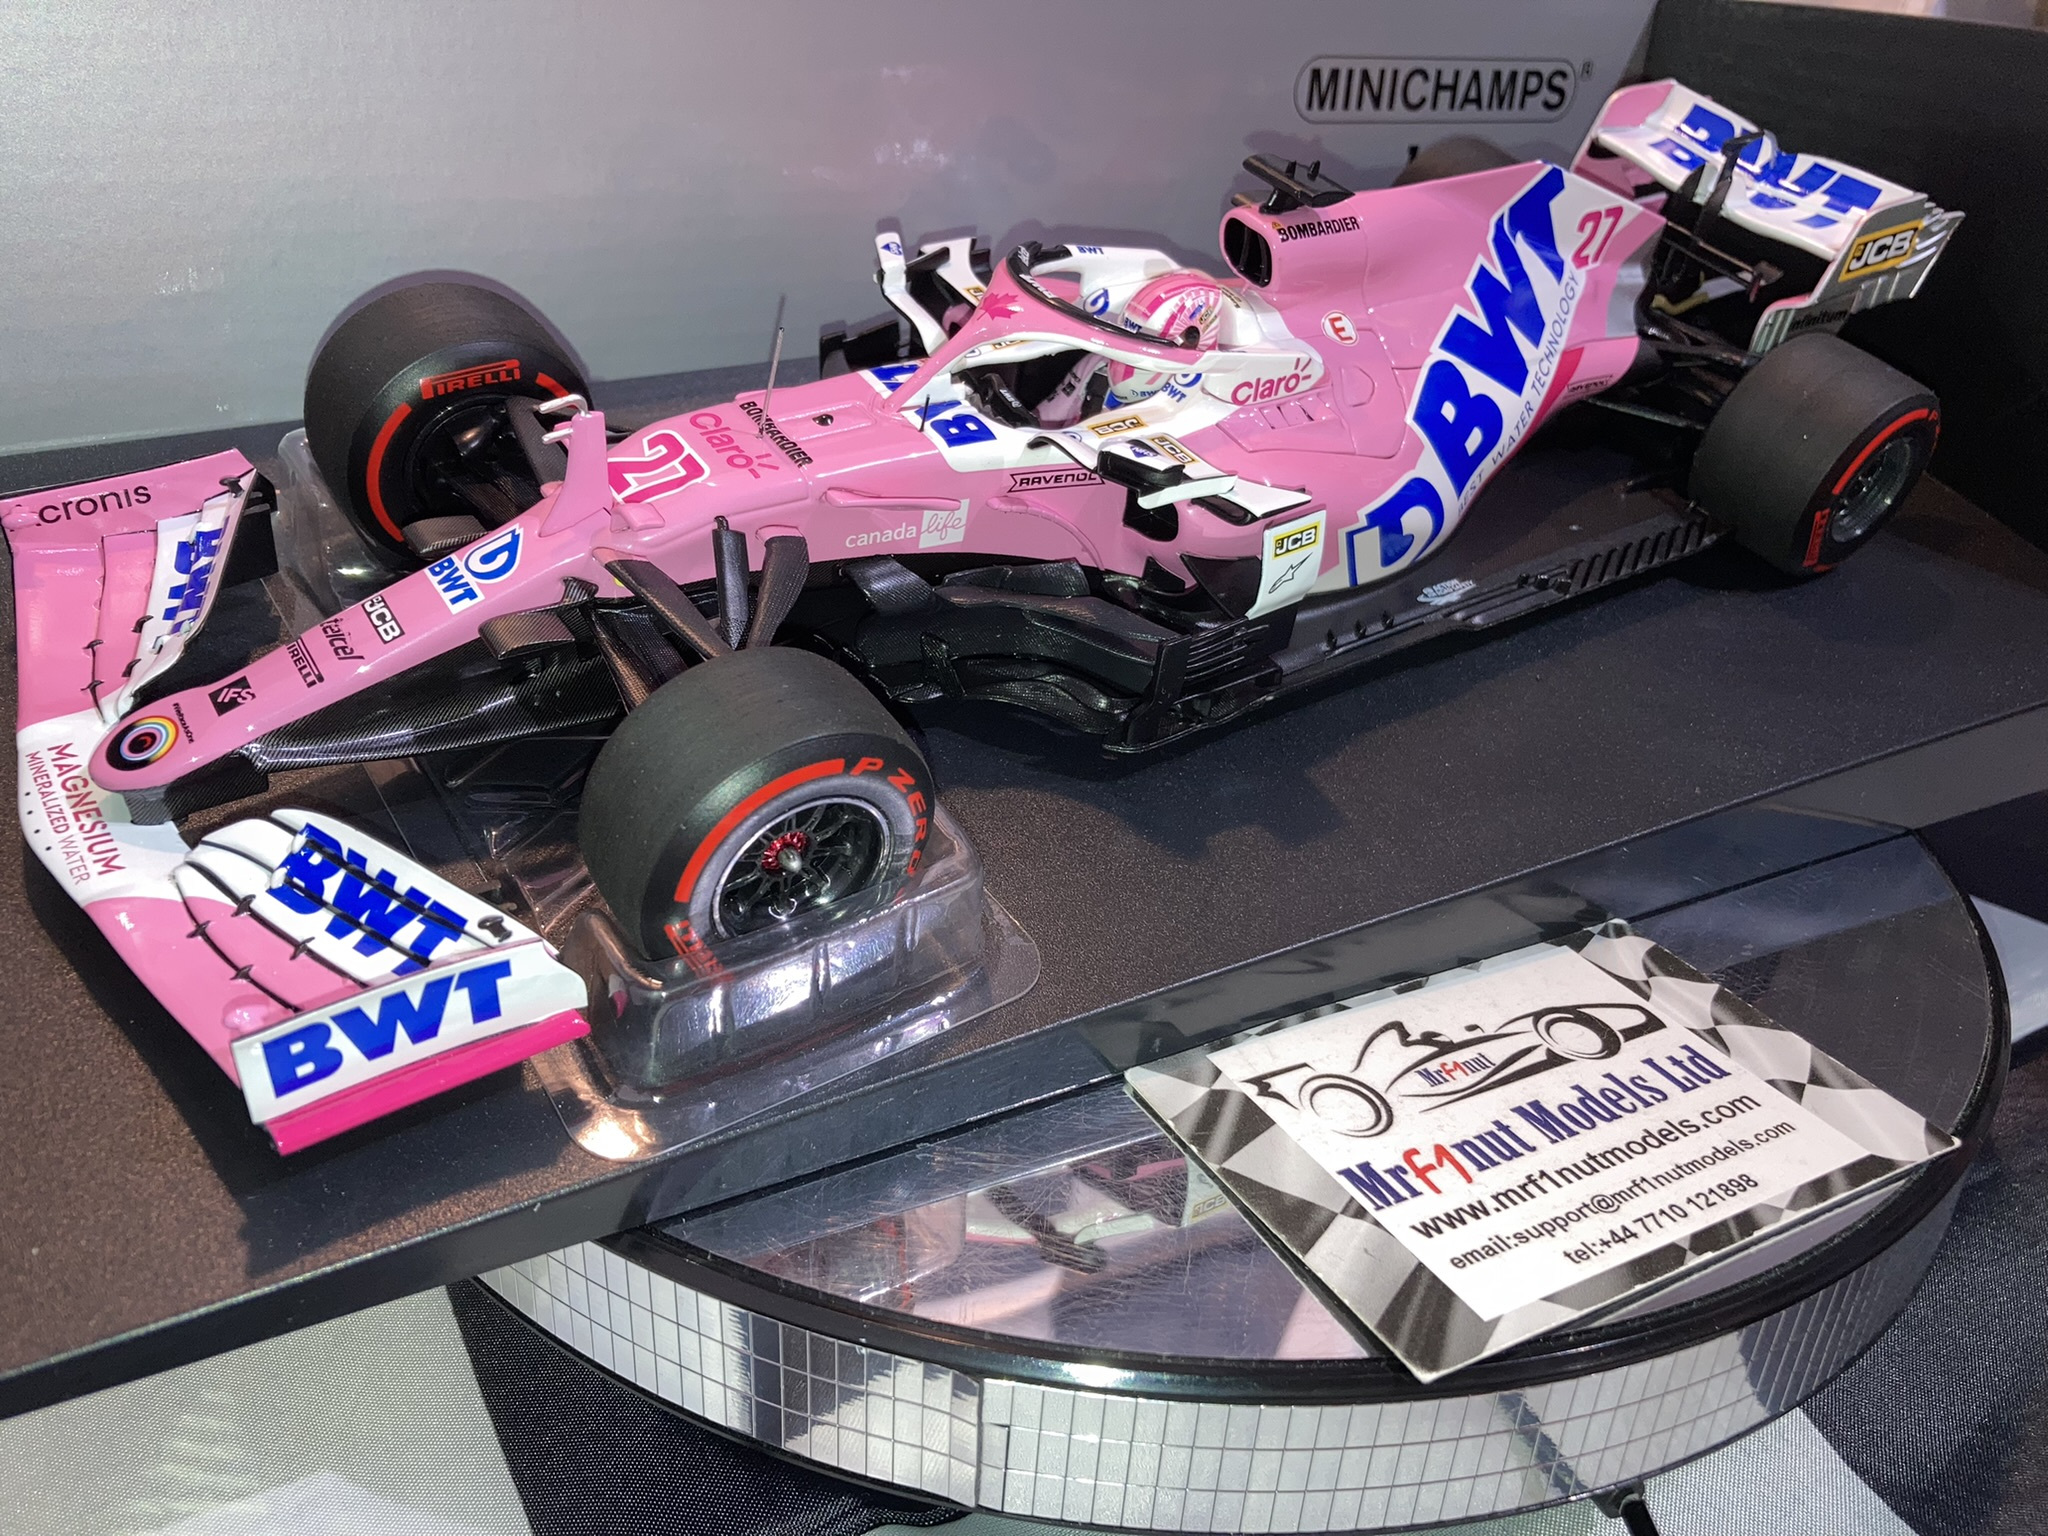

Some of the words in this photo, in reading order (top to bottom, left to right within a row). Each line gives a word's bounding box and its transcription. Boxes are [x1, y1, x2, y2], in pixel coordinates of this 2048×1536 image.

[1305, 68, 1569, 112] MINICHAMPS
[1278, 216, 1361, 242] BOMBARDIER
[1571, 205, 1624, 270] 27
[1850, 230, 1915, 270] JCB
[1328, 316, 1354, 341] E
[1413, 165, 1565, 497] BWT
[419, 358, 521, 400] PIRELLI
[1161, 382, 1187, 403] BWT
[1231, 372, 1301, 406] Claro
[1492, 401, 1534, 466] WATER
[1530, 270, 1580, 397] TECHNOLOGY
[688, 412, 756, 470] Claro
[606, 428, 711, 505] 27
[1018, 471, 1098, 488] RAVENOL
[9, 484, 152, 532] cronis
[845, 522, 917, 549] canada
[920, 509, 967, 541] life
[1275, 528, 1316, 556] JCB
[427, 556, 479, 606] BWT
[362, 597, 402, 644] JCB
[216, 687, 257, 705] IFS
[25, 750, 71, 834] MINERALIZED
[57, 834, 92, 886] WATER
[47, 742, 127, 876] MAGNESIUM
[265, 822, 469, 977] BWT
[261, 959, 512, 1099] BWT
[1509, 1072, 1669, 1145] Models
[1640, 1043, 1733, 1094] Ltd
[1409, 1094, 1762, 1239] www.mrf1nutmodels.com
[1449, 1119, 1797, 1269] email:support@mrf1nutmodels.com
[1562, 1223, 1639, 1265] tel:+44
[1631, 1203, 1690, 1234] 7710
[1685, 1172, 1759, 1214] 121898
